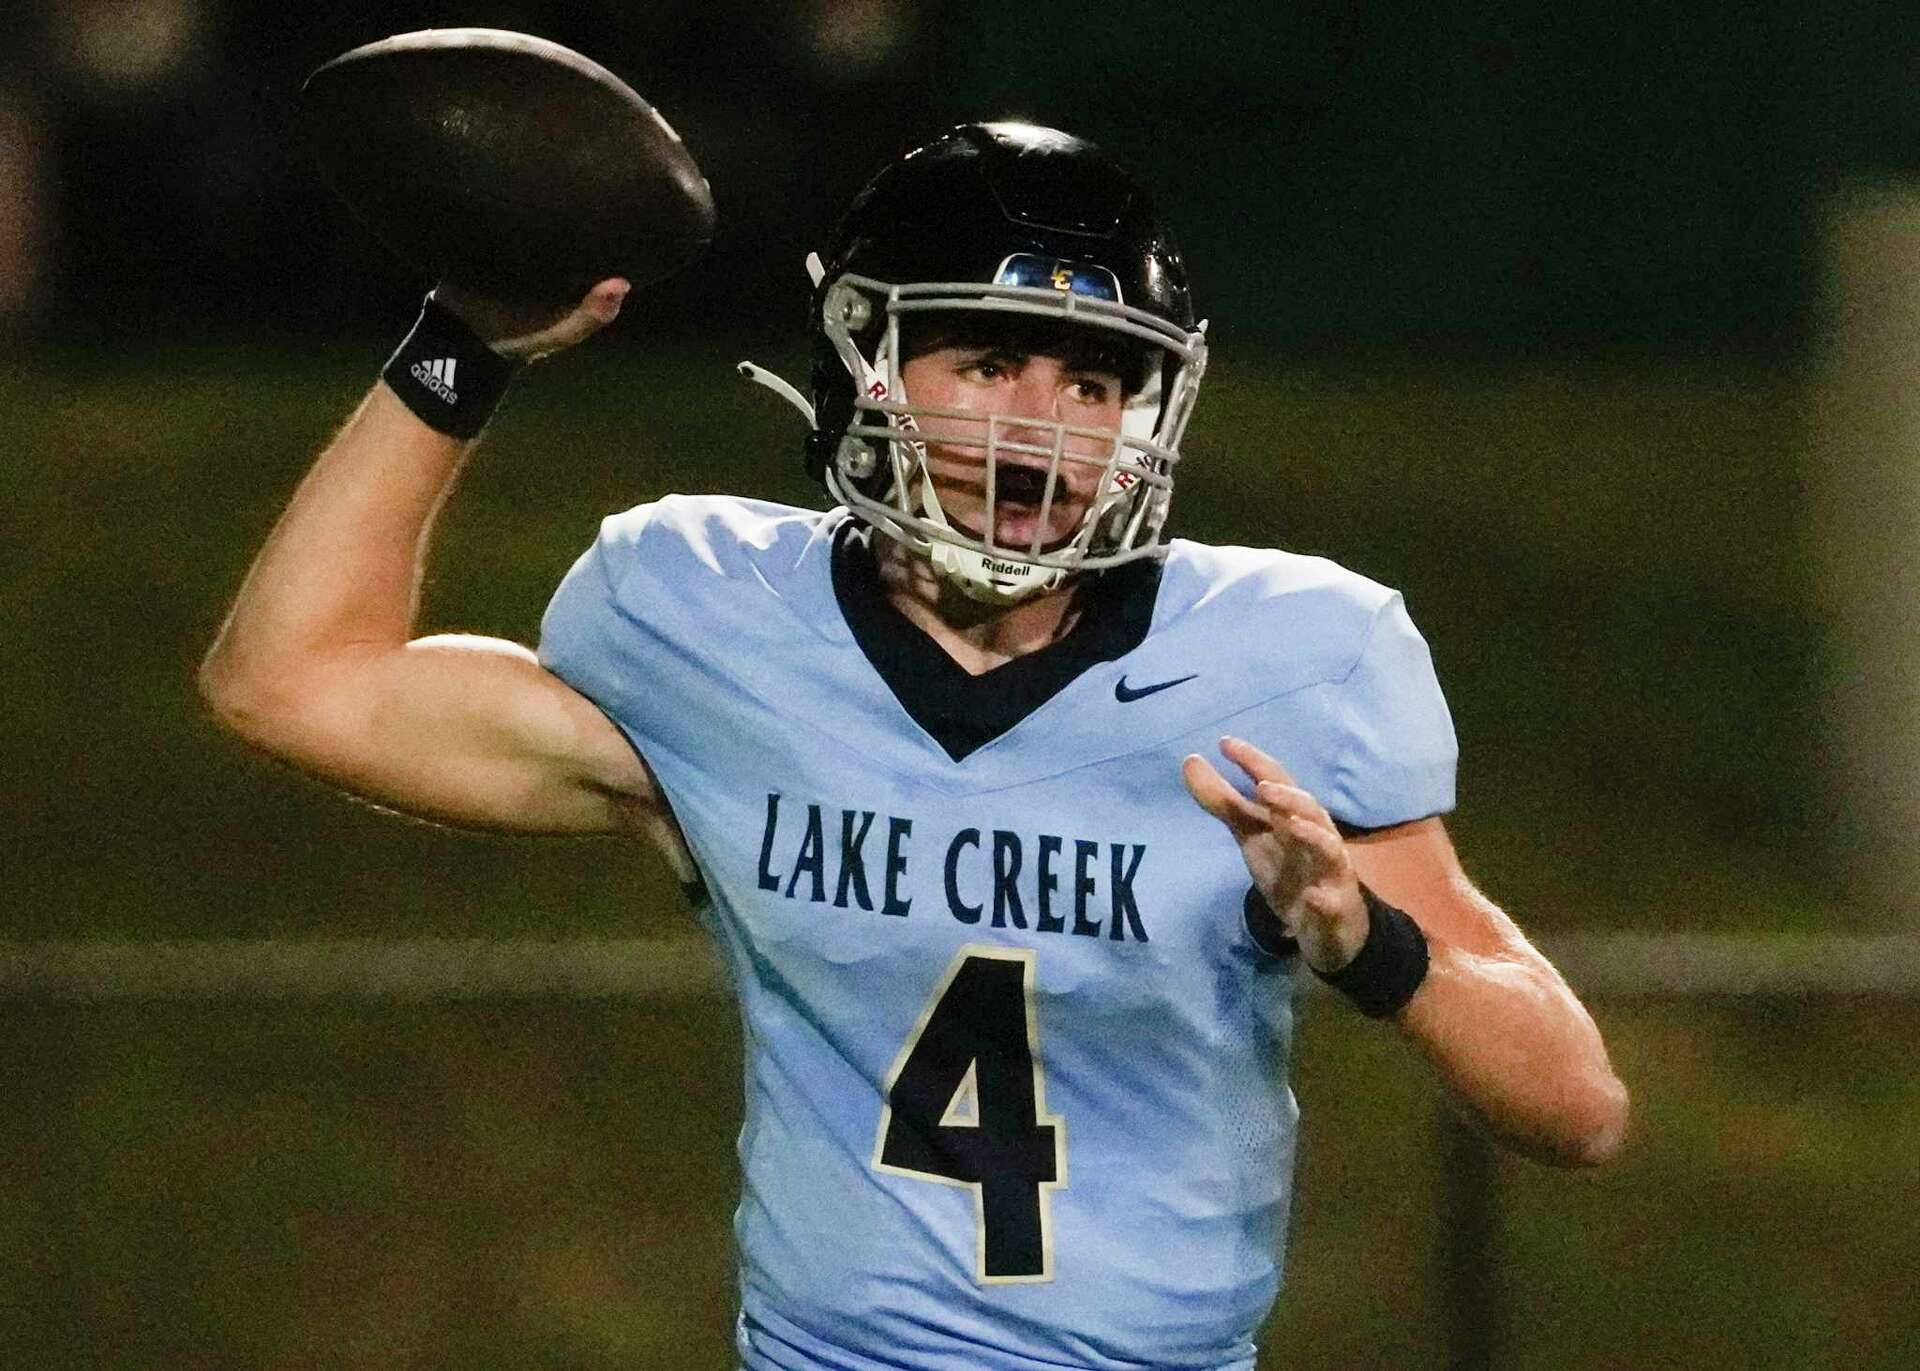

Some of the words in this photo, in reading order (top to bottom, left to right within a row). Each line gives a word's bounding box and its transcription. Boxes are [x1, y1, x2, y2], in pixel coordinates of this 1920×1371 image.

[410, 363, 458, 405] adidas
[981, 557, 1031, 576] Riddell
[757, 793, 913, 918] LAKE
[943, 827, 1149, 942] CREEK
[871, 944, 1068, 1284] 4
